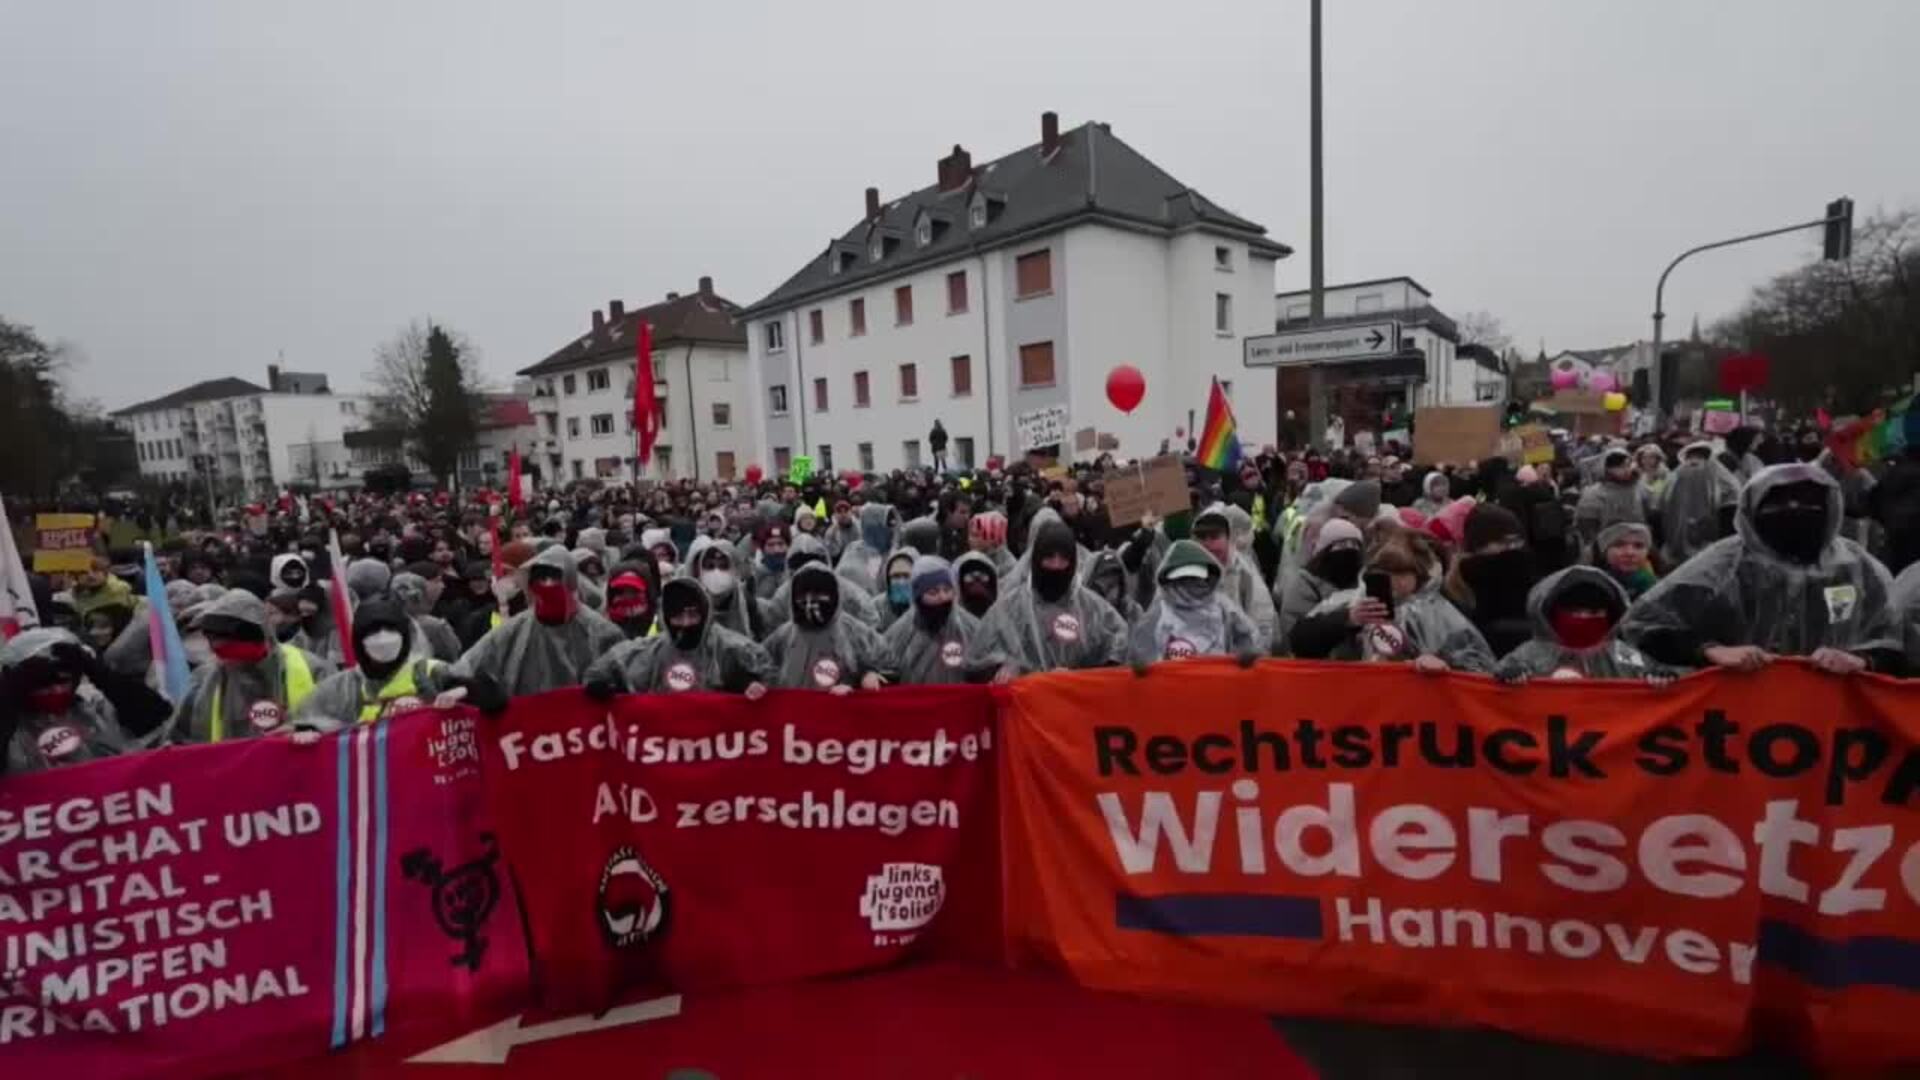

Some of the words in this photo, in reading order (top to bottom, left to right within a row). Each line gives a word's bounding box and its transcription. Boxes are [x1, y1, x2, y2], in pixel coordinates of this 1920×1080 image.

[499, 711, 768, 770] Faschismus
[1093, 715, 1608, 779] Rechtsruck
[224, 803, 321, 847] UND
[676, 789, 959, 835] zerschlagen
[0, 866, 185, 923] APITAL
[871, 879, 939, 908] jugend
[889, 864, 931, 883] links
[1335, 897, 1758, 985] Hannover
